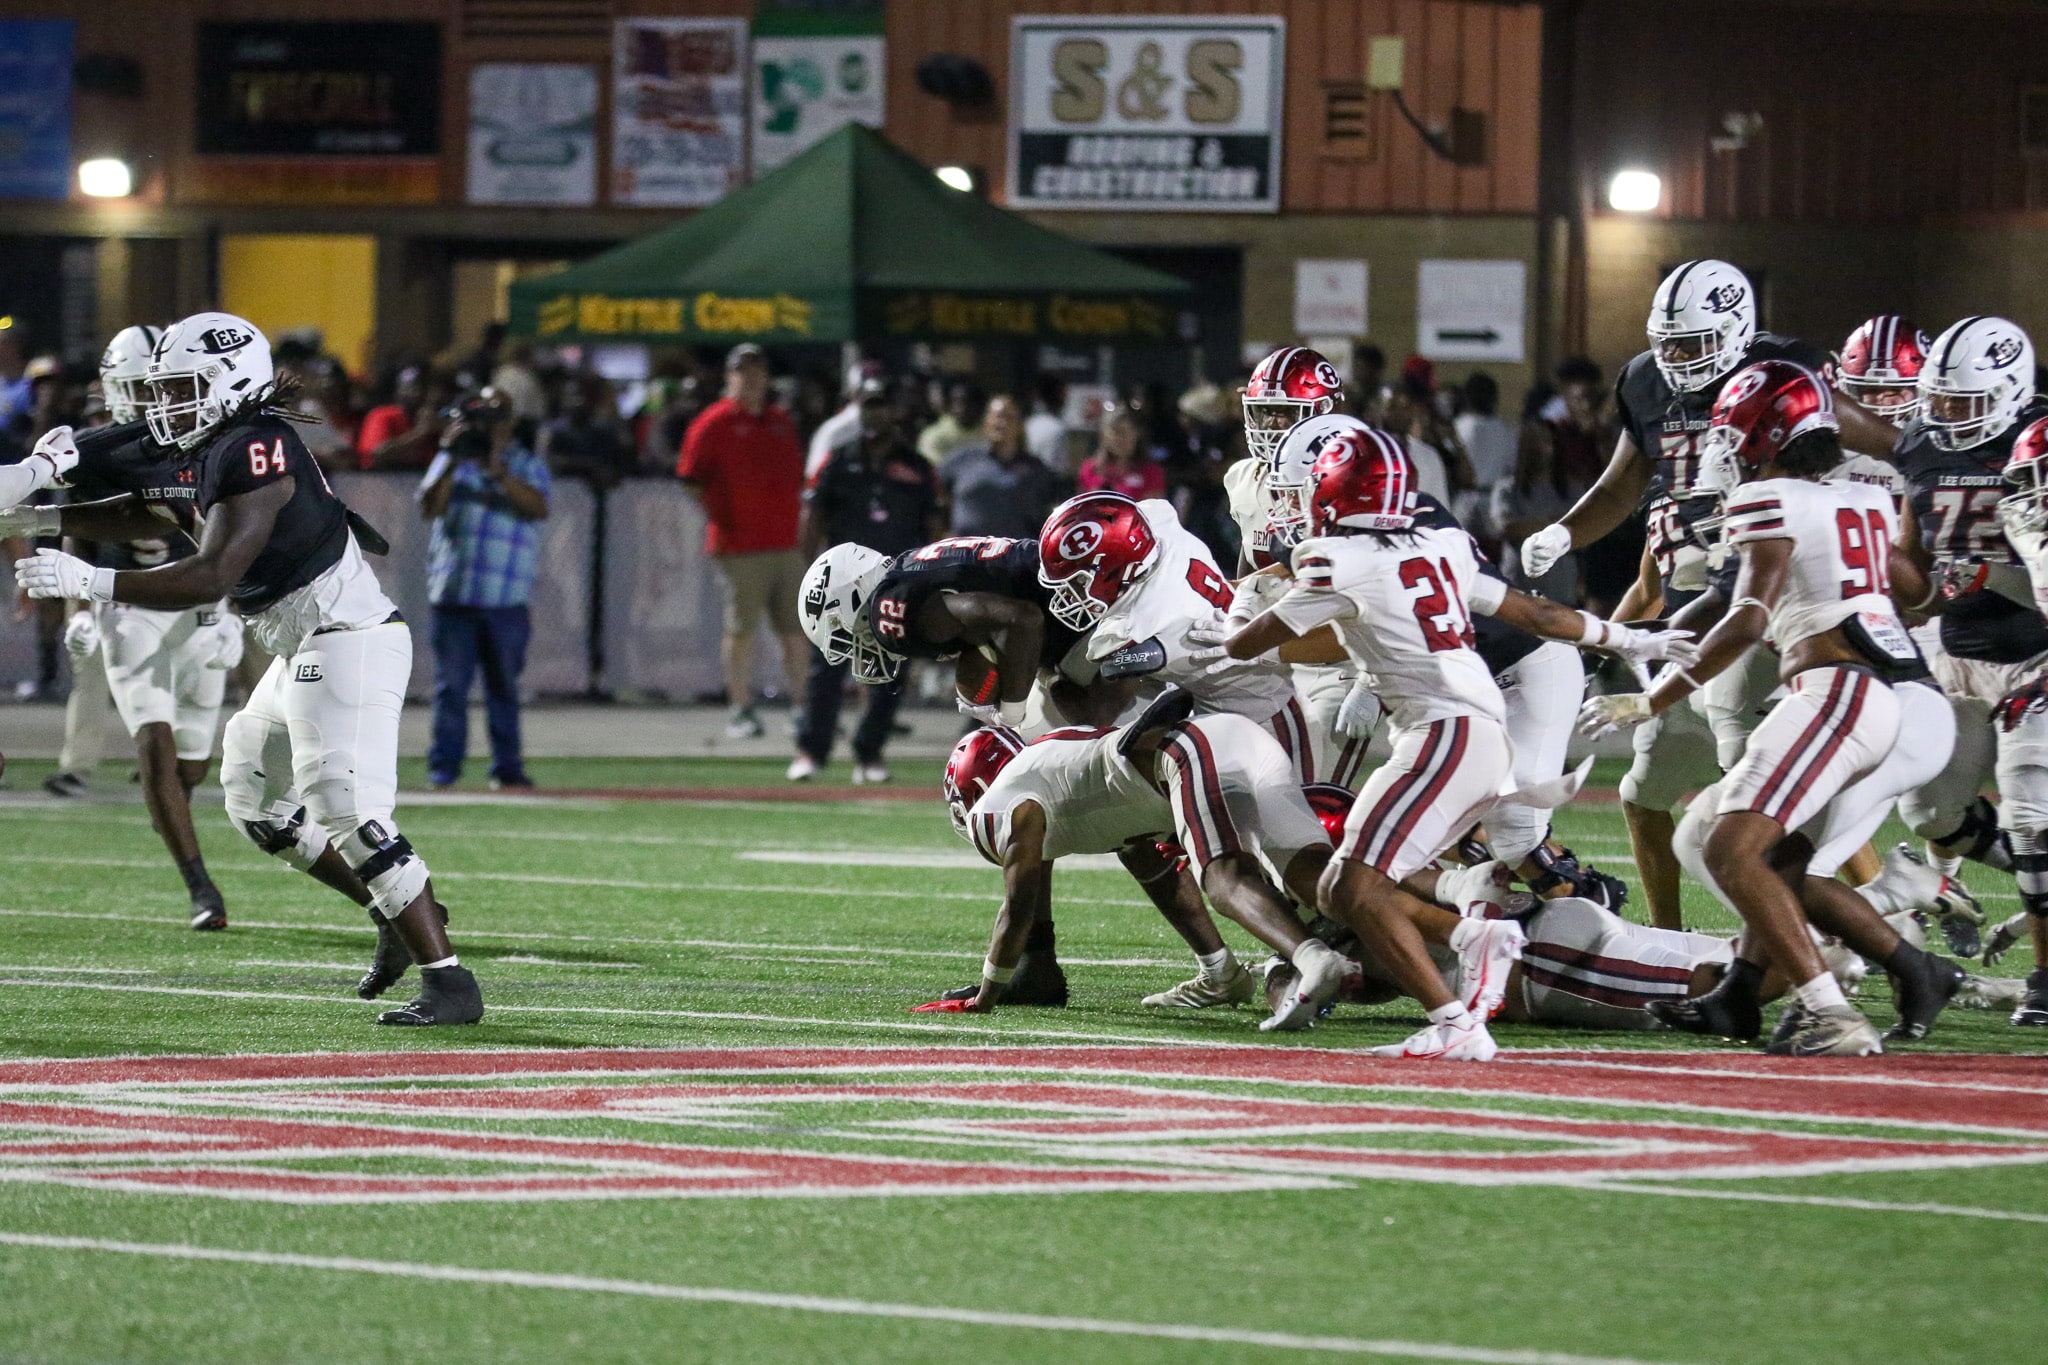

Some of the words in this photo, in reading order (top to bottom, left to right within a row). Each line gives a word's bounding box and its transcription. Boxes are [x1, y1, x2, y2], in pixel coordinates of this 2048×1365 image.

[1050, 37, 1243, 124] S&S
[200, 328, 253, 355] LEE
[1663, 421, 1681, 432] LEE
[249, 438, 286, 476] 64
[143, 488, 161, 499] LEE
[164, 487, 197, 499] COUNTY
[1938, 475, 1959, 486] LEE
[1063, 525, 1098, 556] R
[1931, 490, 2011, 564] 72
[1836, 508, 1892, 601] 90
[879, 597, 908, 640] 32
[1398, 556, 1477, 653] 21
[295, 664, 323, 682] LEE
